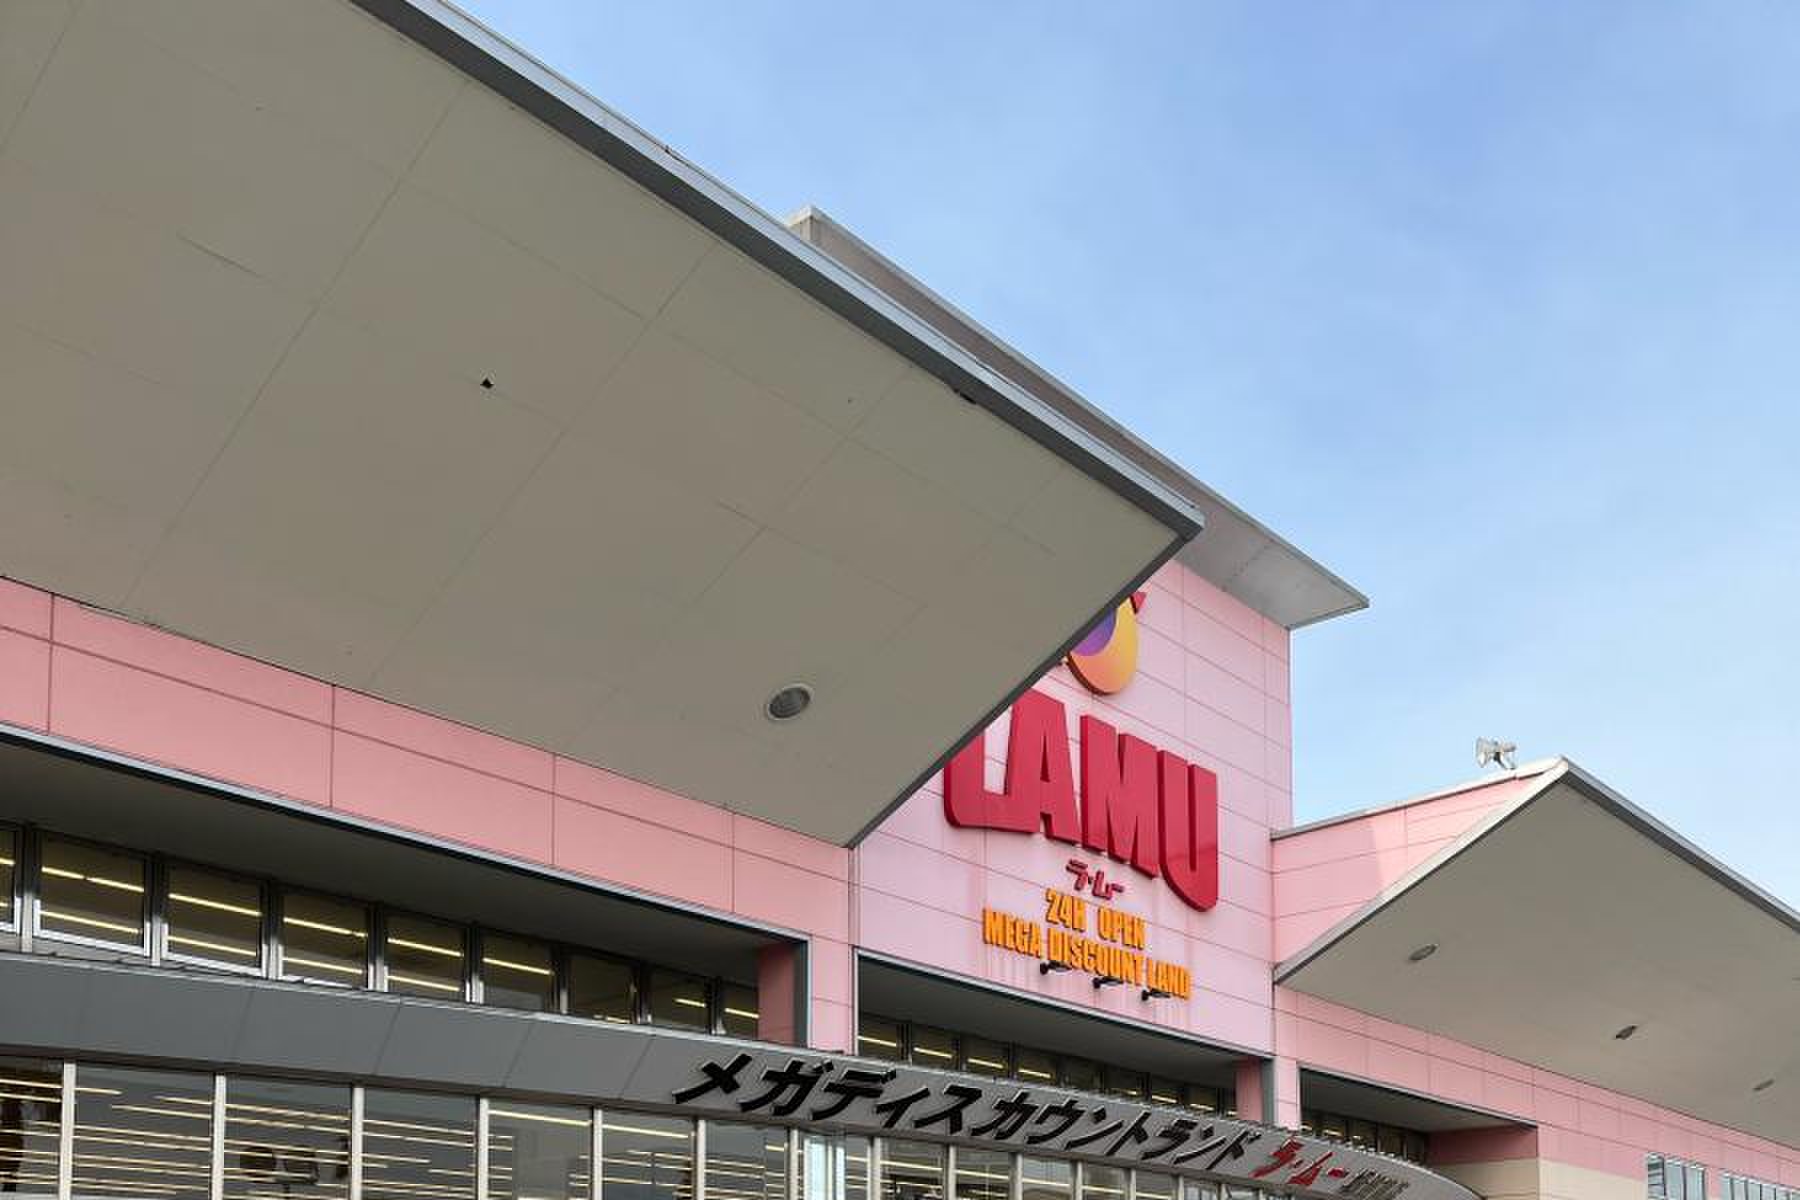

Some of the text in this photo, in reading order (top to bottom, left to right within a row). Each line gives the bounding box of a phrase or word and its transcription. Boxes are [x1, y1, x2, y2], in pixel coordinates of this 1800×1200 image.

[944, 688, 1218, 912] LAMU
[982, 907, 1191, 1000] MEGA DISCOUNT LAND
[1045, 887, 1147, 950] 24H OPEN
[672, 1052, 1262, 1169] メガディスカウントランド
